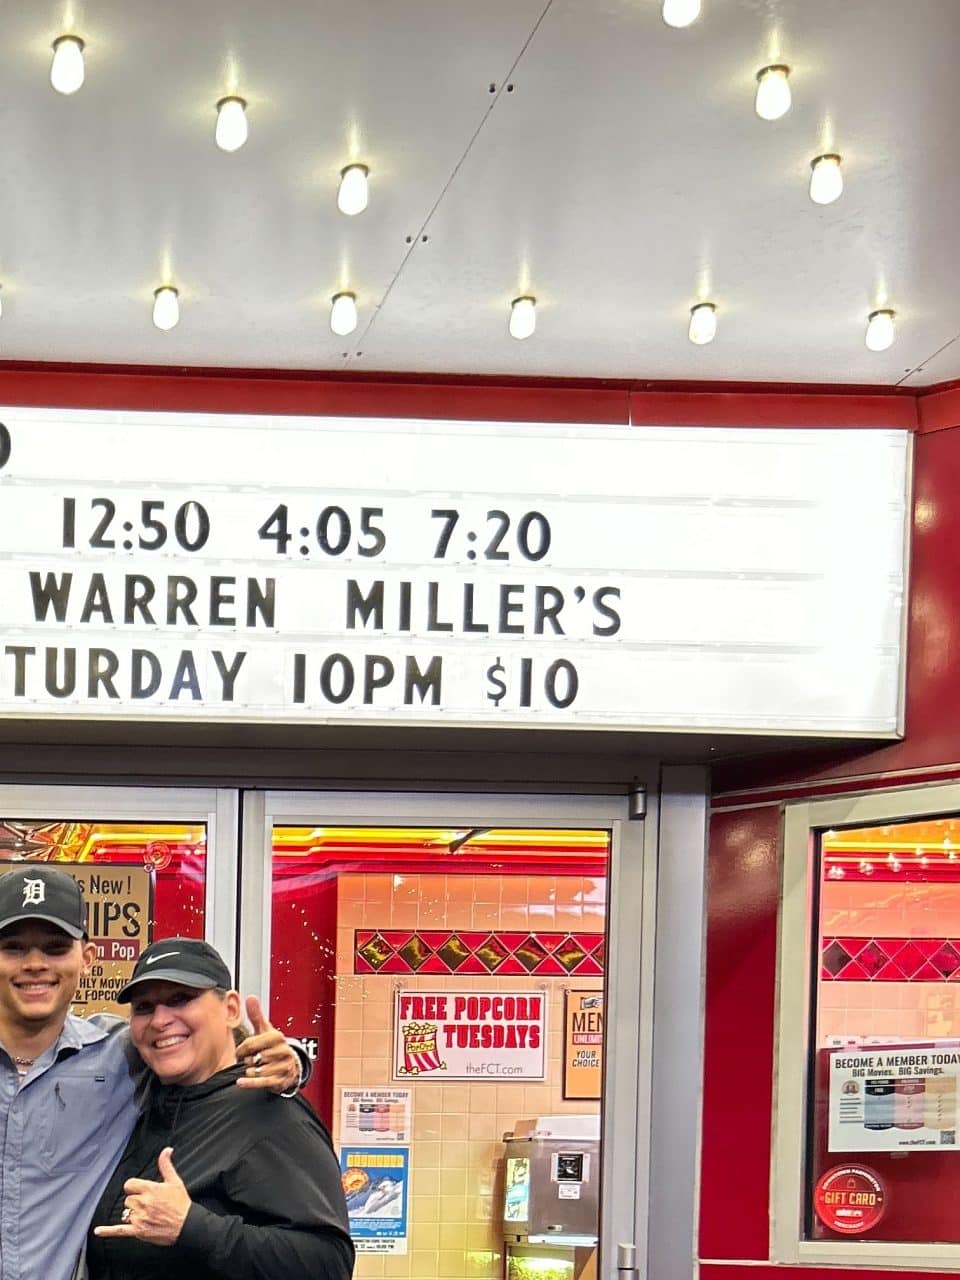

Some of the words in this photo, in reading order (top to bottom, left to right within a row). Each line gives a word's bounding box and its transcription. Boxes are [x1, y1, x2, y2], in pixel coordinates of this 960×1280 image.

[63, 497, 210, 552] 12:50
[257, 504, 386, 557] 4:05
[431, 509, 551, 562] 7:20
[29, 571, 276, 628] WARREN
[346, 579, 622, 636] MILLER'S
[293, 652, 443, 706] 10PM
[486, 656, 578, 708] $10
[91, 875, 123, 895] New
[111, 942, 135, 960] Pop
[400, 997, 448, 1020] FREE
[454, 997, 541, 1020] POPCORN
[443, 1025, 540, 1048] TUESDAYS
[572, 1059, 600, 1067] CHOICE
[576, 1050, 596, 1059] YOUR
[835, 1058, 873, 1068] BECOME
[877, 1057, 883, 1066] A
[886, 1055, 928, 1066] MEMBER
[466, 1063, 523, 1075] theFCT.com
[852, 1069, 865, 1077] BIG
[898, 1067, 912, 1075] BIG
[824, 1191, 846, 1205] GIFT
[848, 1192, 876, 1206] CARD
